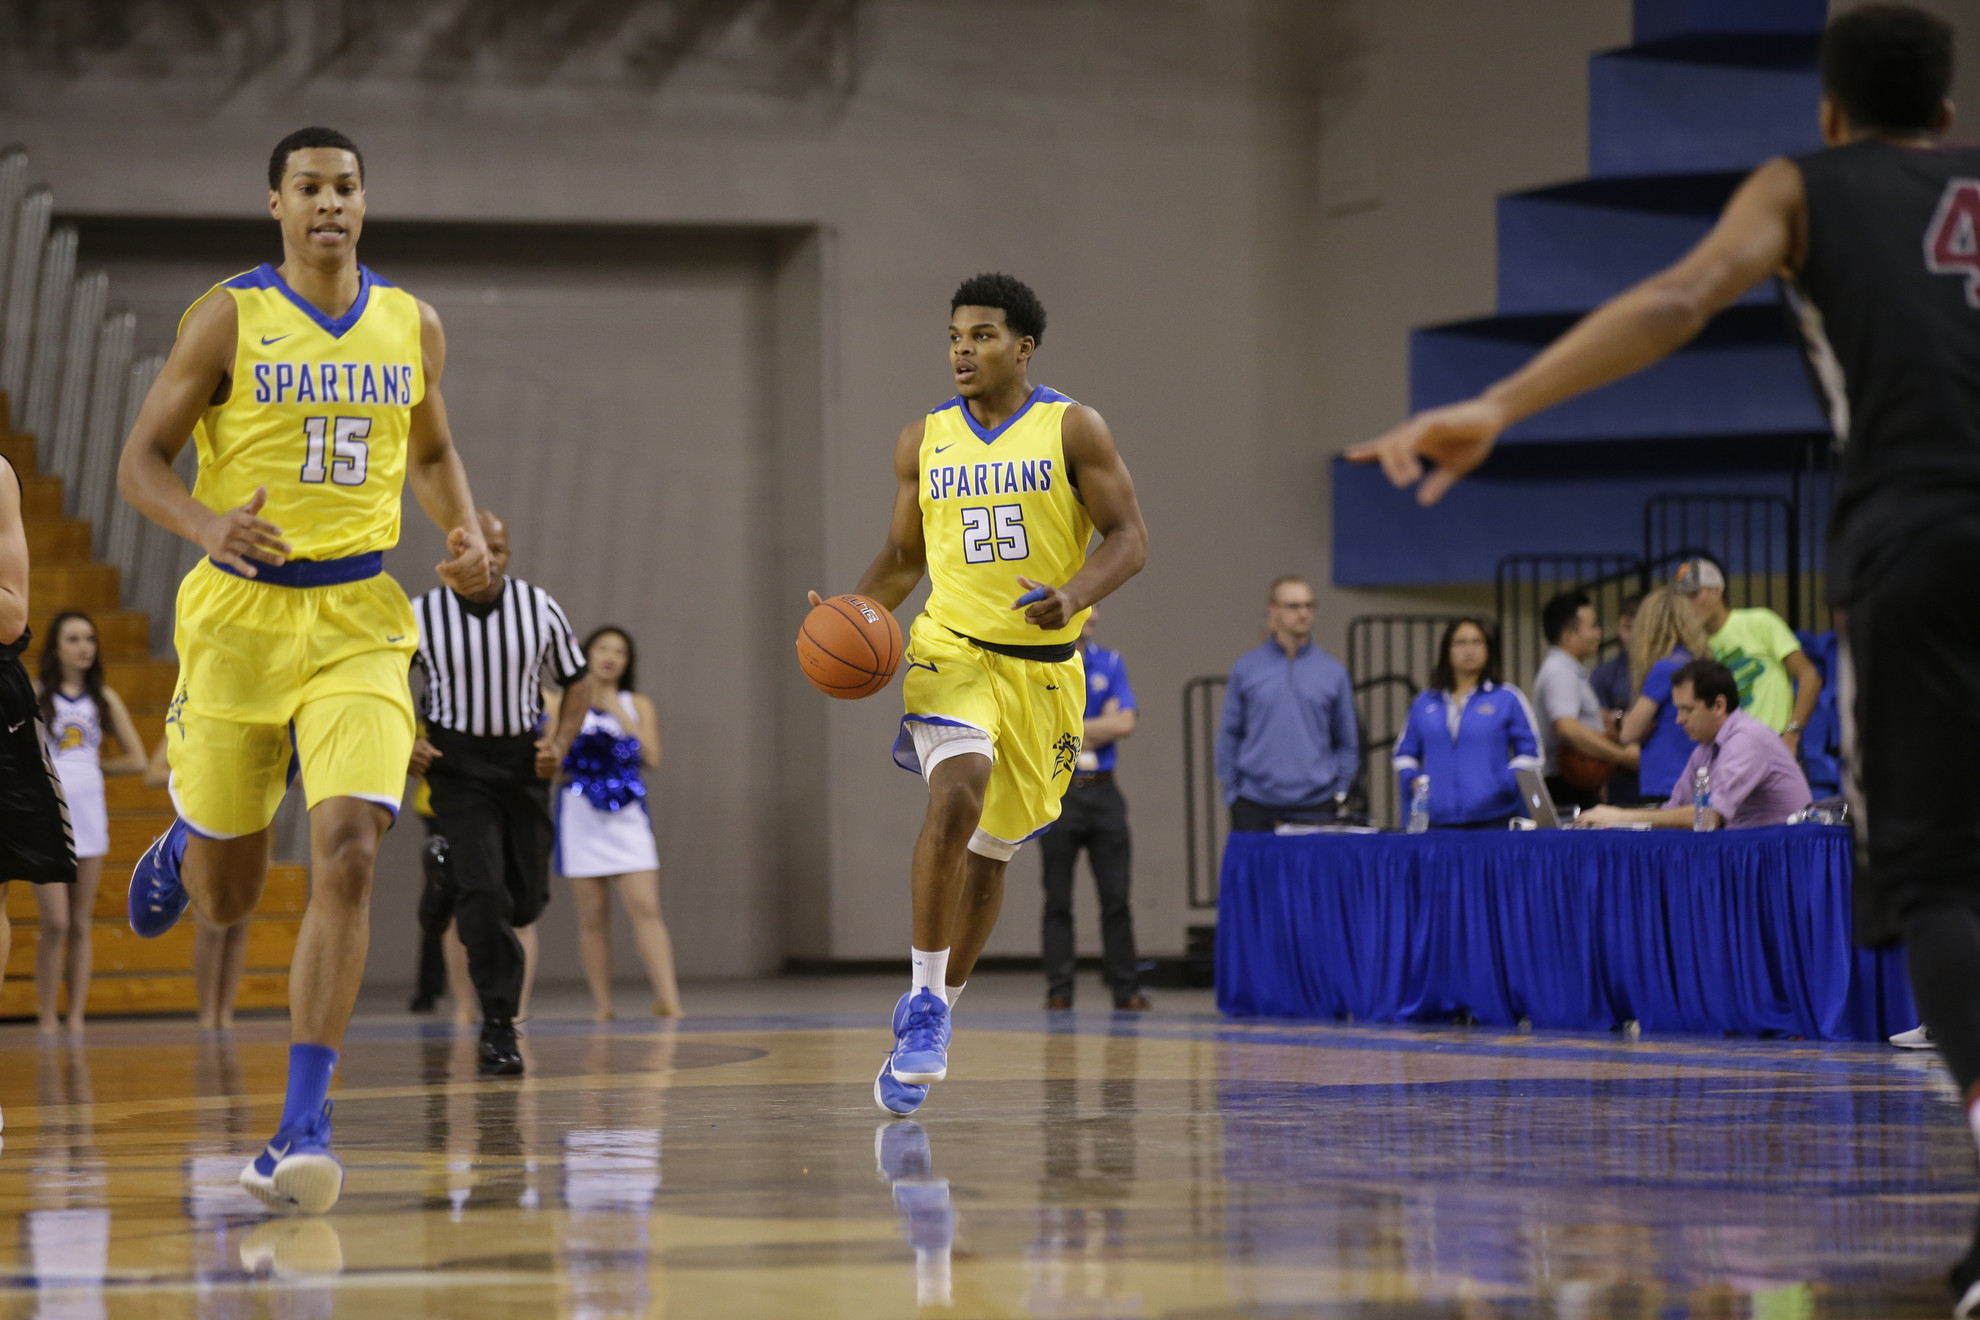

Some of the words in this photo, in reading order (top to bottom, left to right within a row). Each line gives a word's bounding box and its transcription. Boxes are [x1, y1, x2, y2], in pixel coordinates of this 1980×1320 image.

[1922, 177, 1980, 309] 4
[254, 363, 412, 406] SPARTANS
[300, 416, 372, 486] 15
[929, 459, 1053, 500] SPARTANS
[961, 504, 1030, 564] 25
